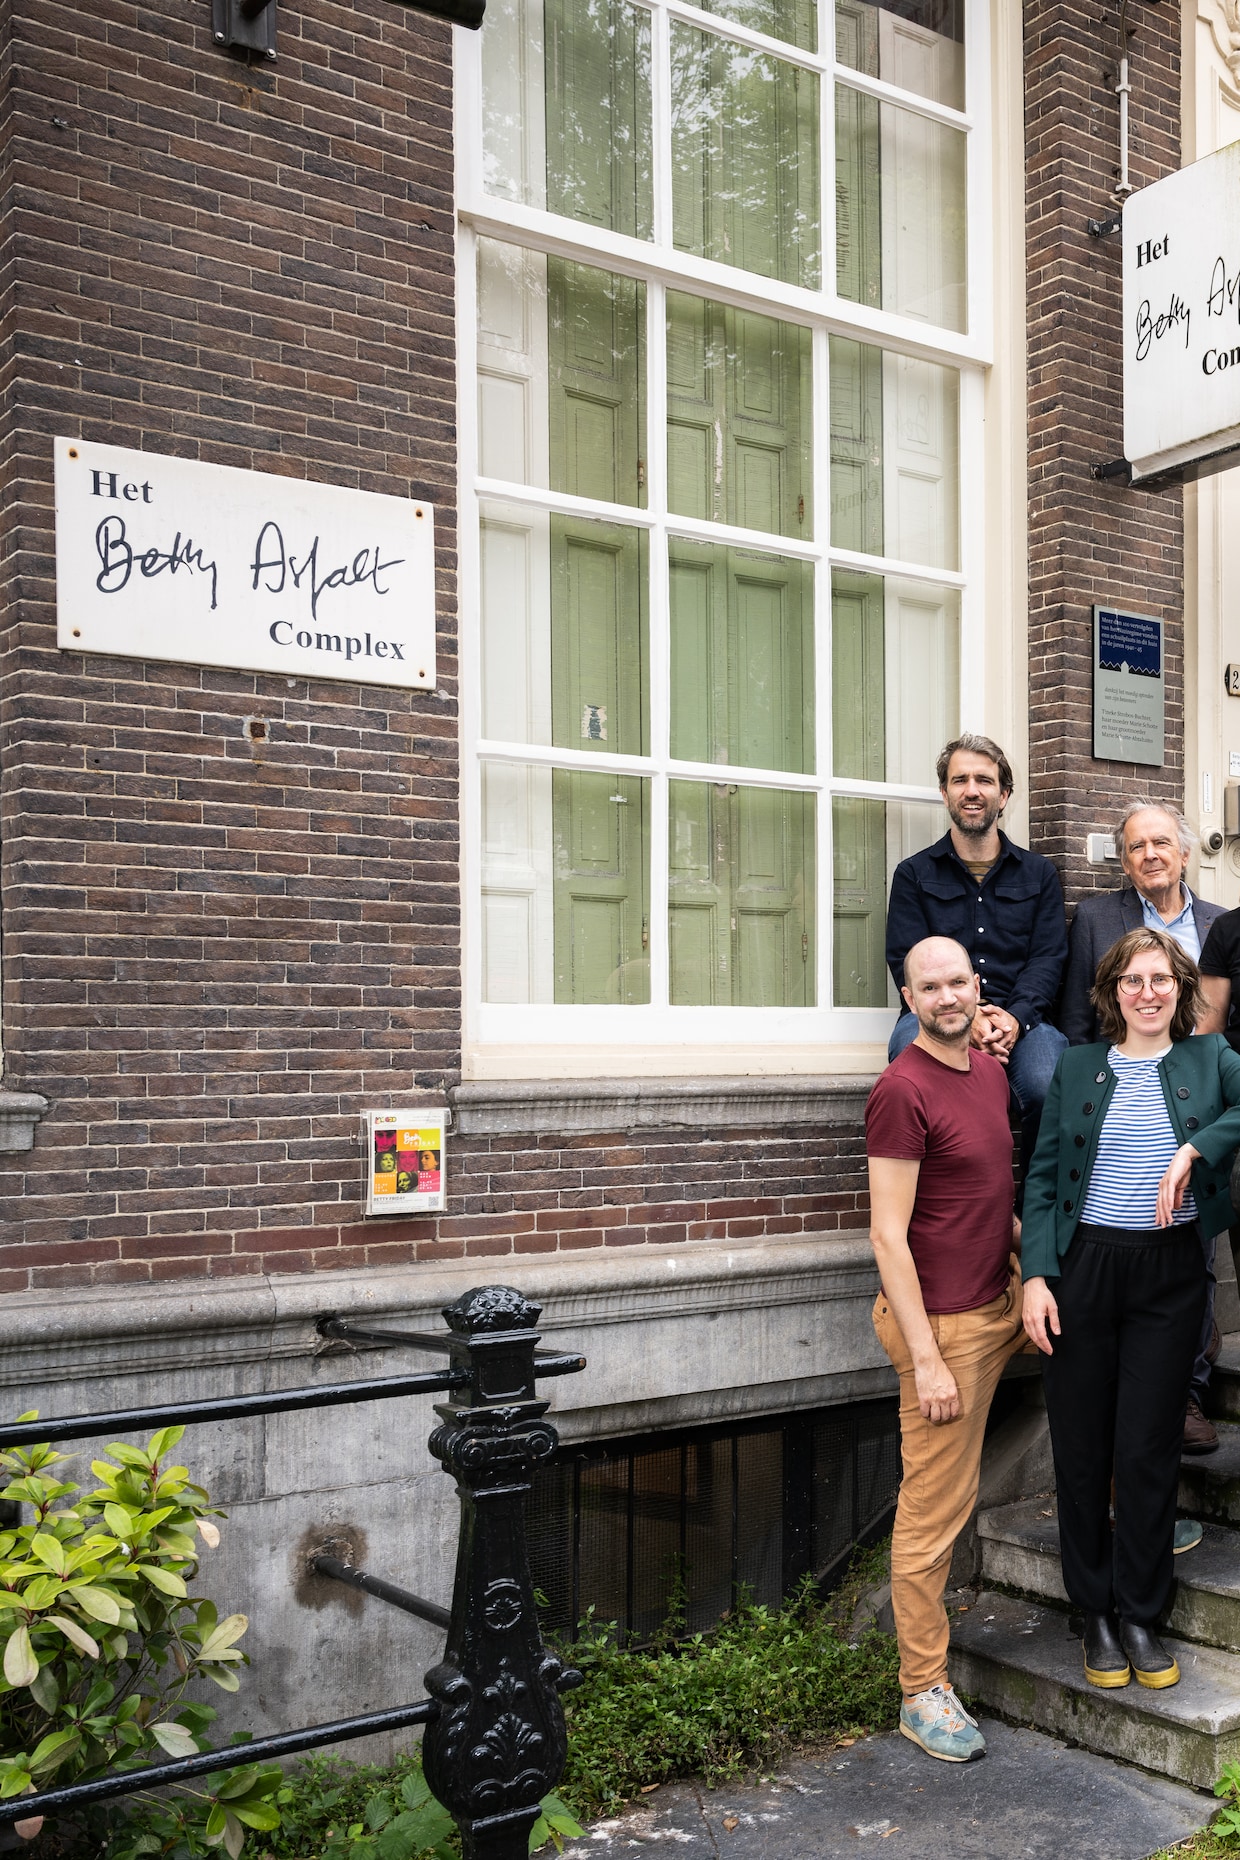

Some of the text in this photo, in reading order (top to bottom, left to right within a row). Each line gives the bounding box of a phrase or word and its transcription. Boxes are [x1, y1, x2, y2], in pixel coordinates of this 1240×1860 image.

[1136, 234, 1170, 269] Het
[1136, 293, 1191, 361] Betty
[90, 469, 154, 504] Het
[96, 516, 405, 621] Betty Asfalt
[269, 620, 406, 661] Complex
